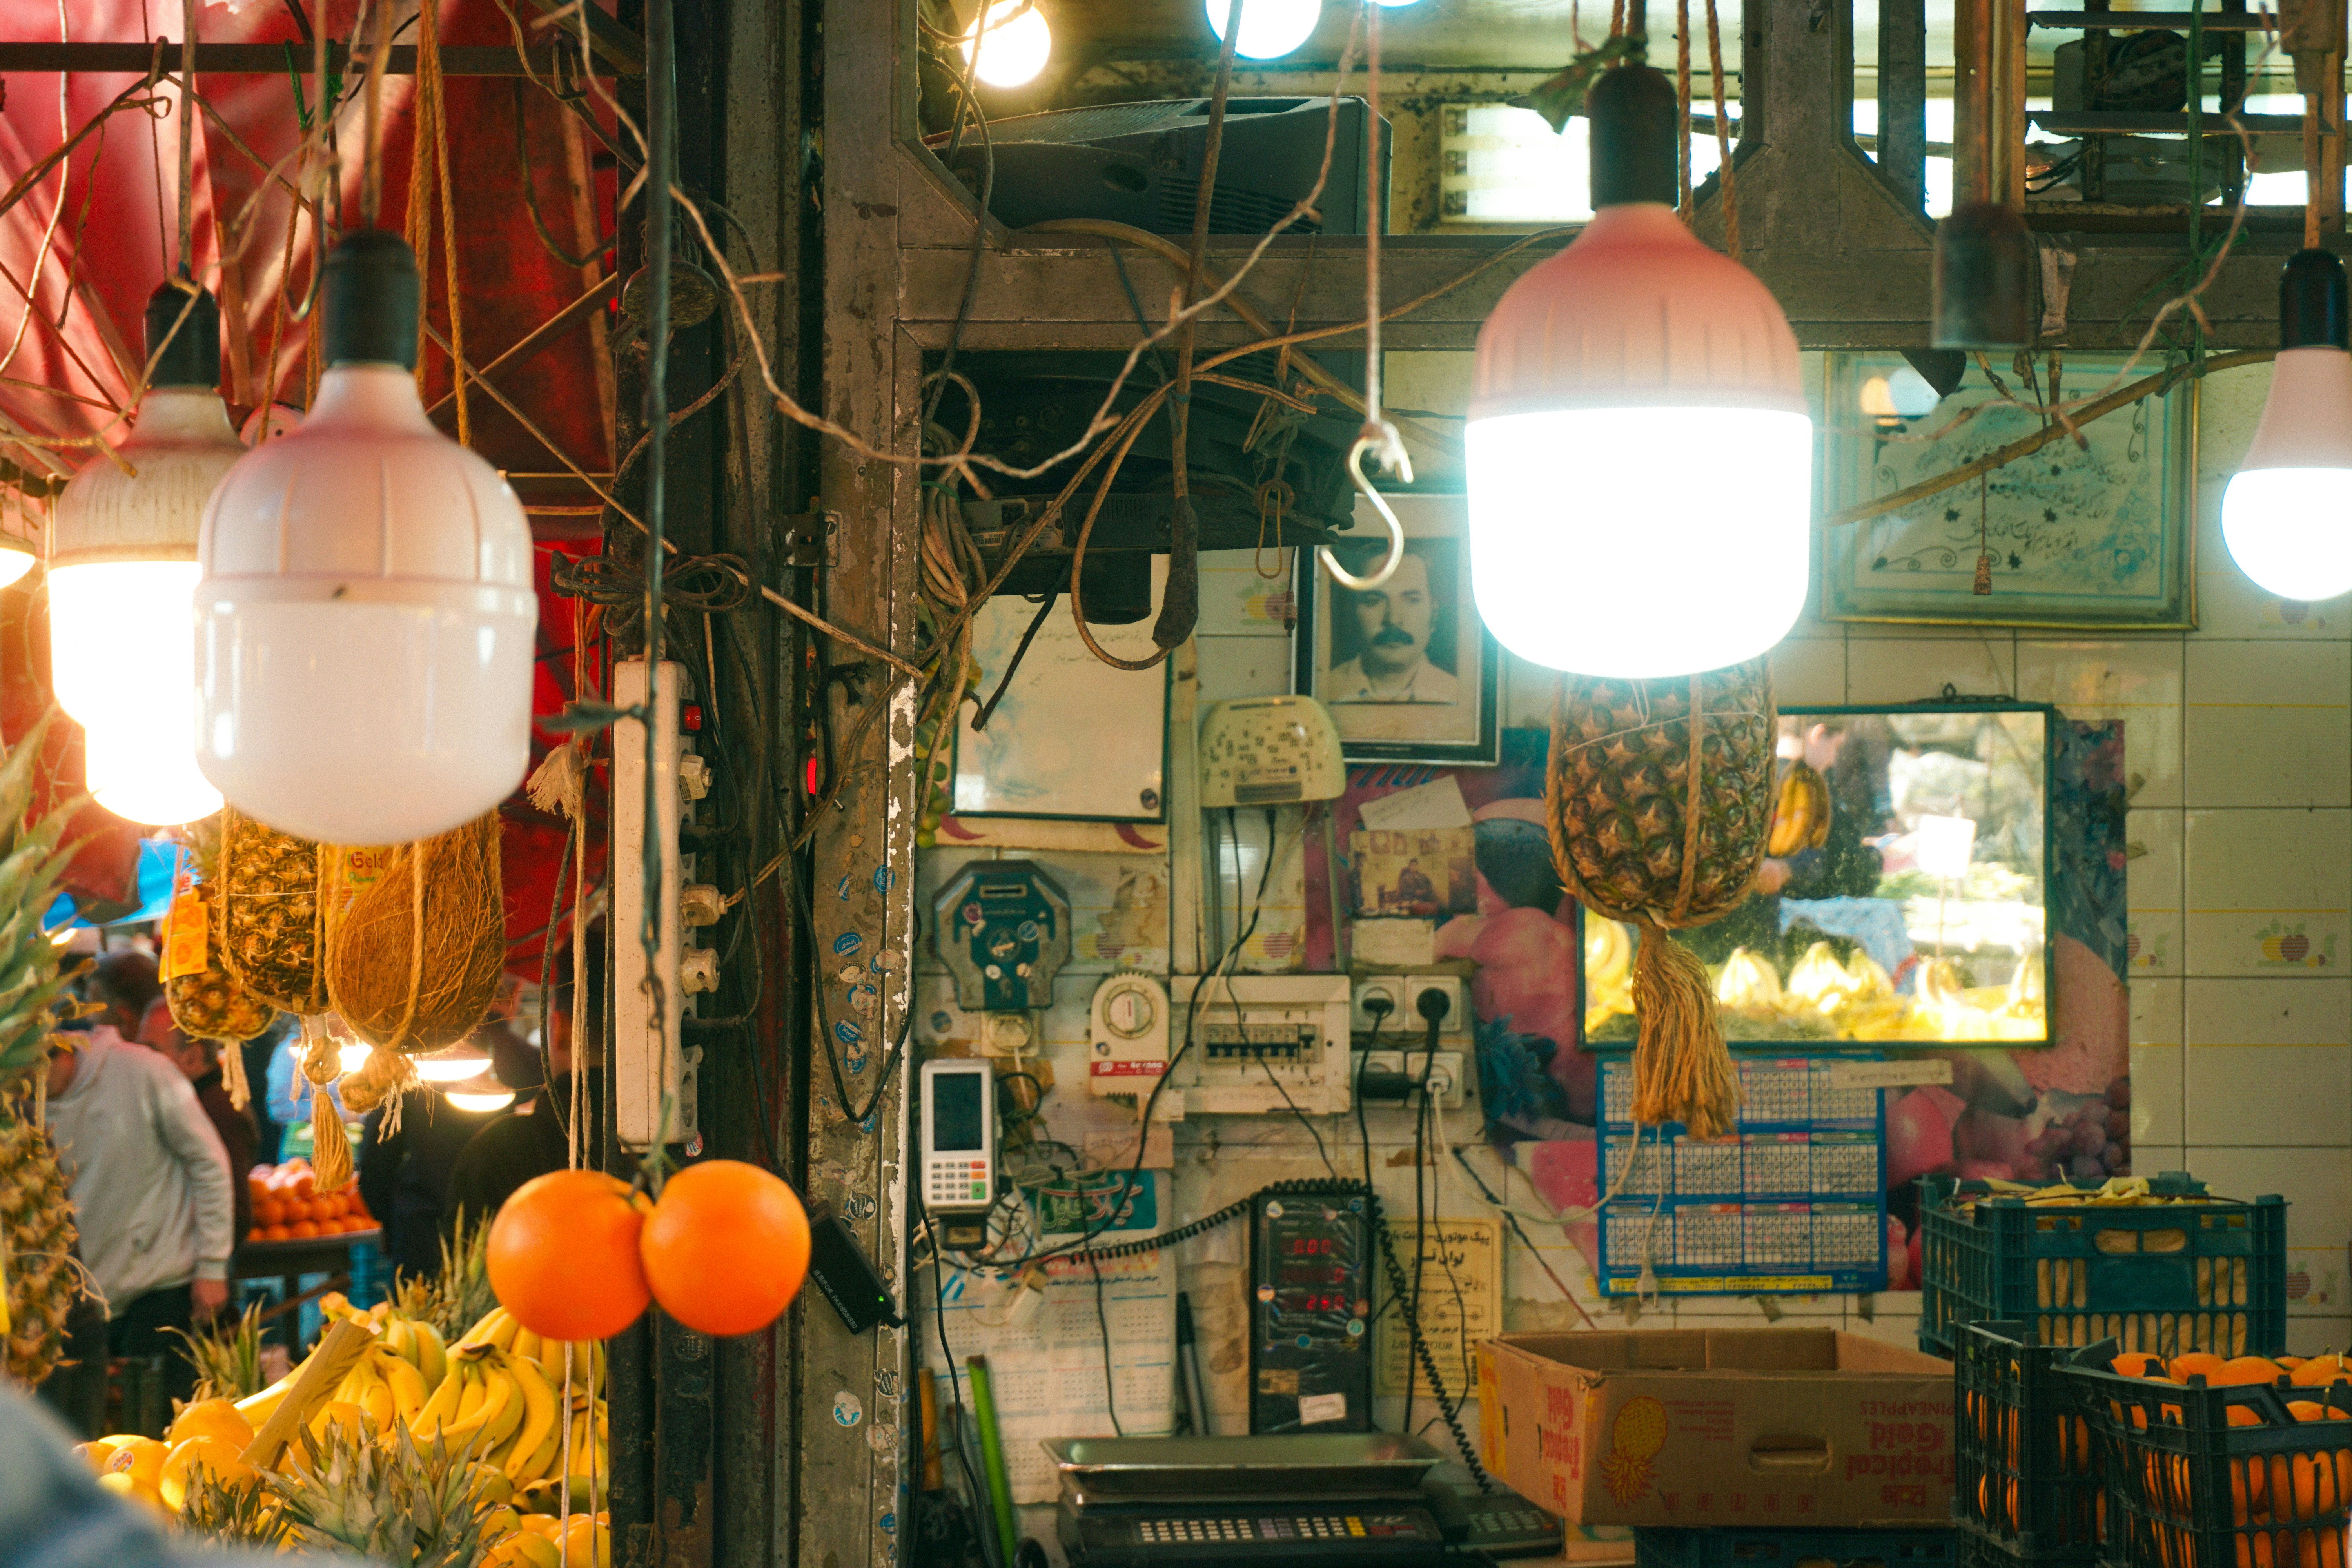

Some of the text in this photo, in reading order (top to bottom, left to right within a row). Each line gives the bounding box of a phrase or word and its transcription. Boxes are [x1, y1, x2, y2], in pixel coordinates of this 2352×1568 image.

[351, 851, 383, 869] Gold
[1859, 1401, 1955, 1416] PINEAPPLES
[1844, 1449, 1955, 1485] Tropical
[1881, 1485, 1926, 1508] Dole
